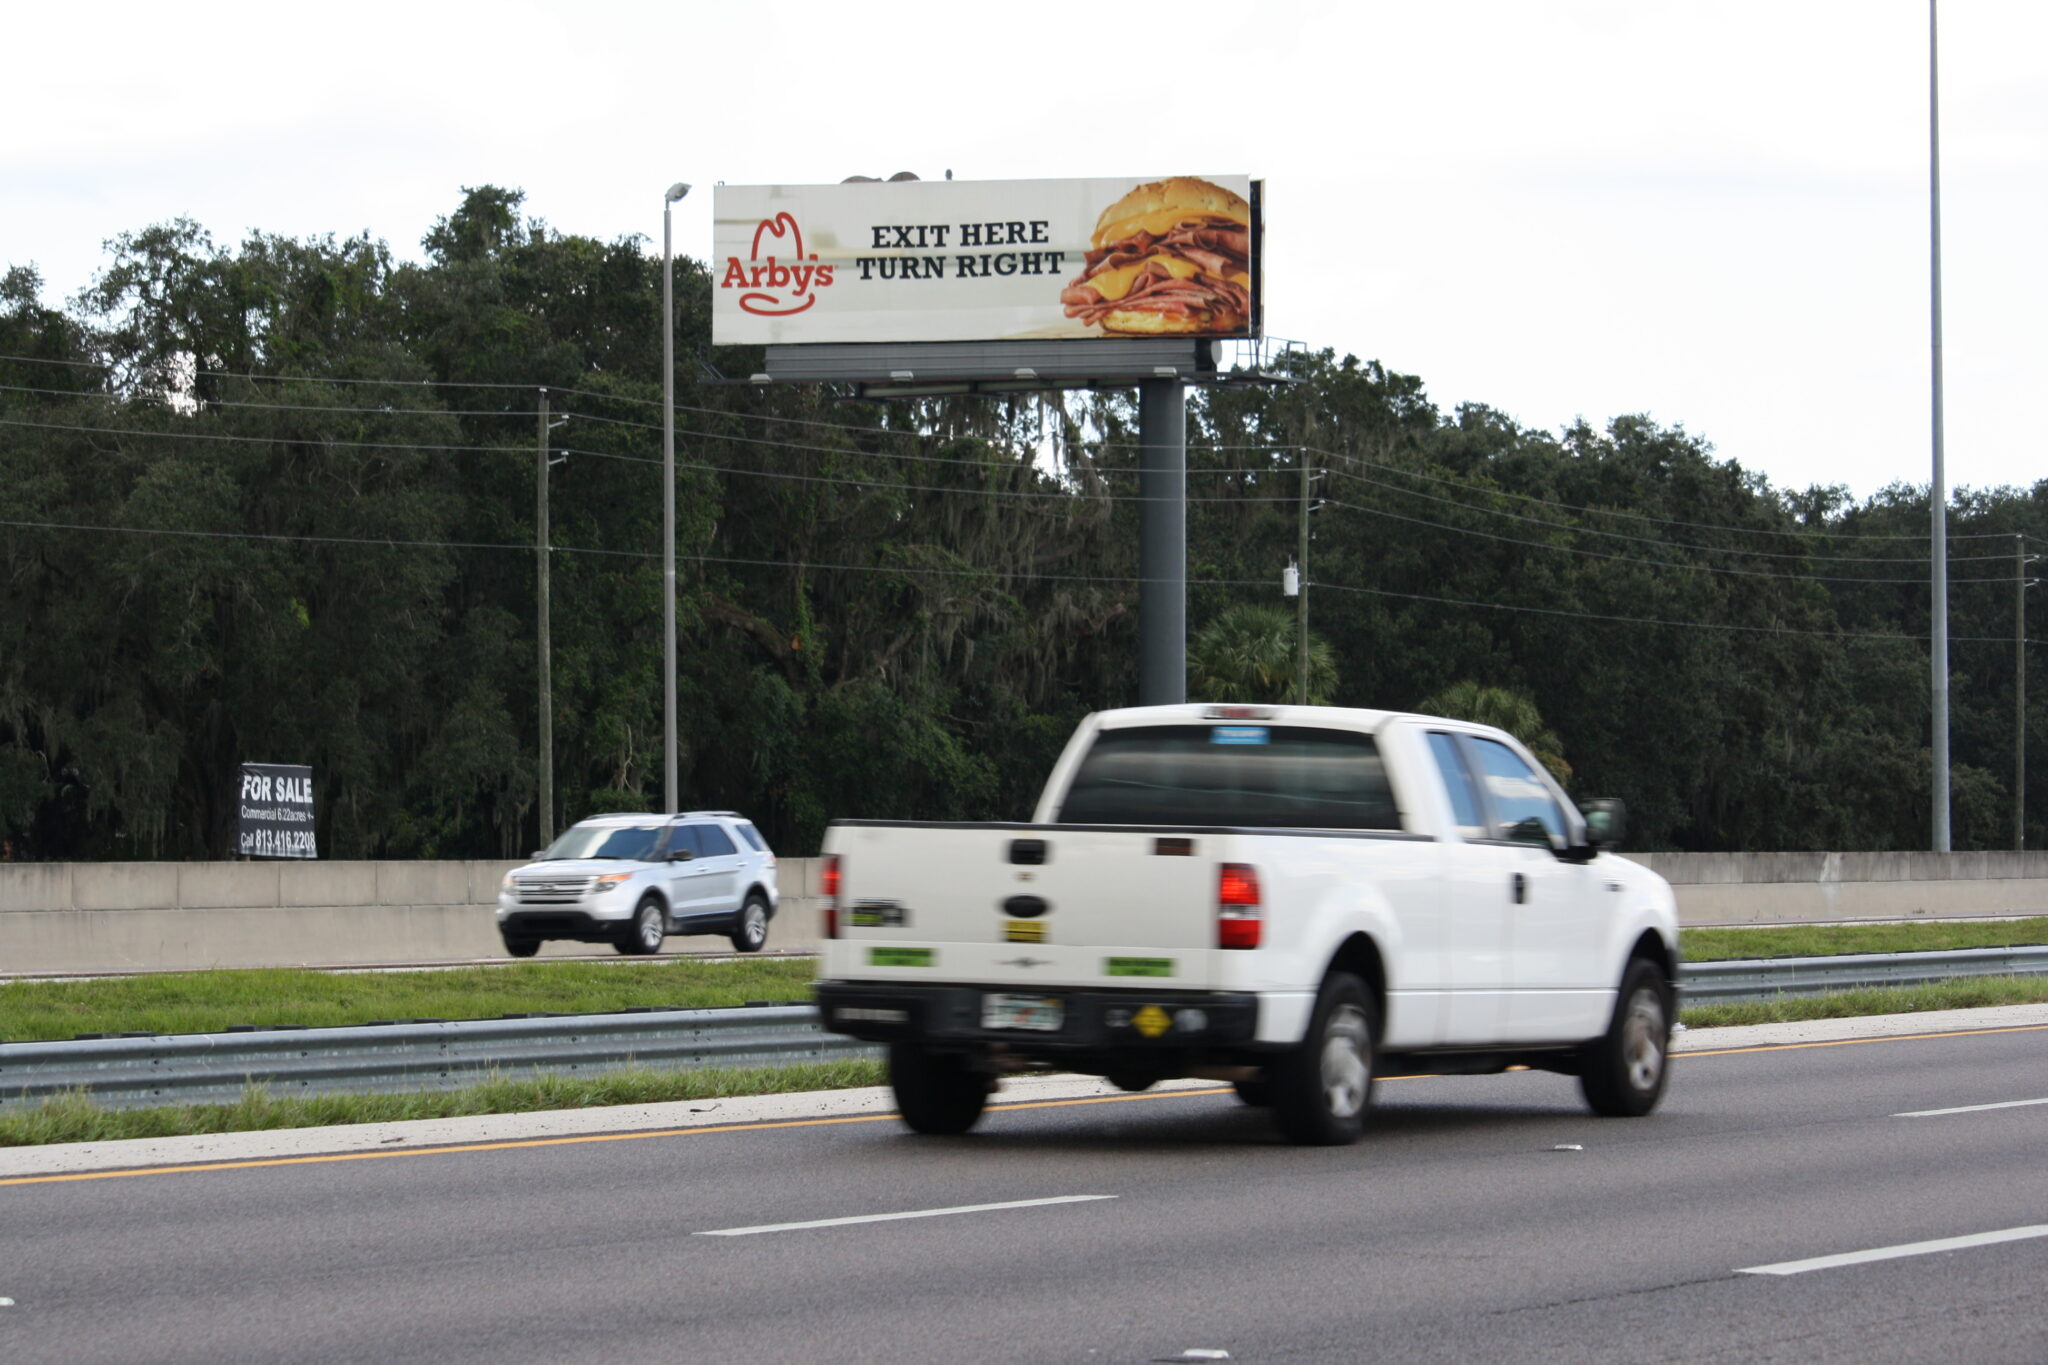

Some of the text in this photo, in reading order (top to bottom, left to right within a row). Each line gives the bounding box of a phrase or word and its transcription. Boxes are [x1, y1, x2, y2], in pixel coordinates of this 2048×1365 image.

[871, 220, 1049, 249] EXIT HERE
[721, 253, 834, 296] Arby's
[856, 251, 1066, 280] TURN RIGHT
[242, 775, 313, 803] FOR SALE
[241, 805, 277, 821] Commercial
[241, 833, 254, 848] Call
